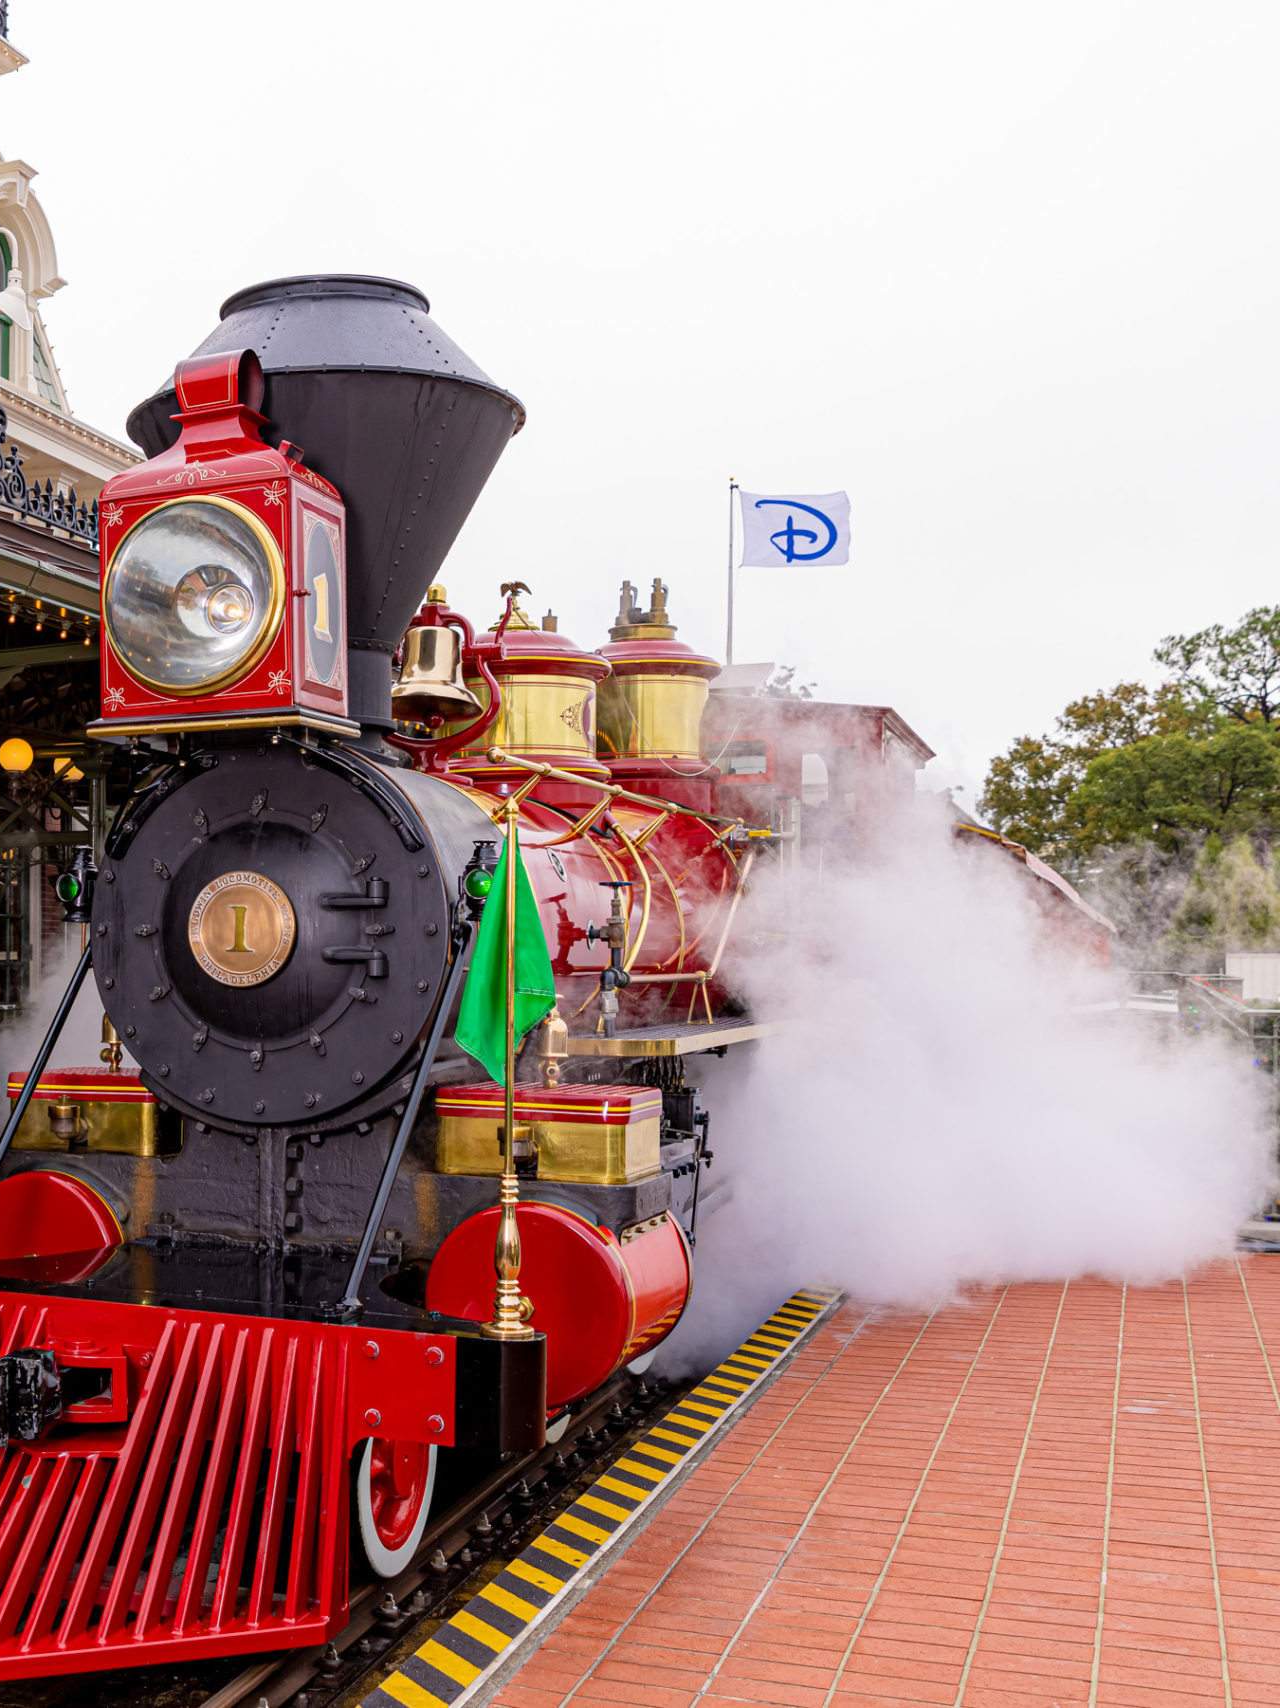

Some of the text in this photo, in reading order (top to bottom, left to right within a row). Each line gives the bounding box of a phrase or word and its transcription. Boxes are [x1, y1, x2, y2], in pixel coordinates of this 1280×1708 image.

[313, 572, 334, 644] 1
[215, 873, 281, 900] LOCOMOTIVE
[225, 904, 256, 952] 1
[199, 953, 282, 985] PHILADELPHIA
